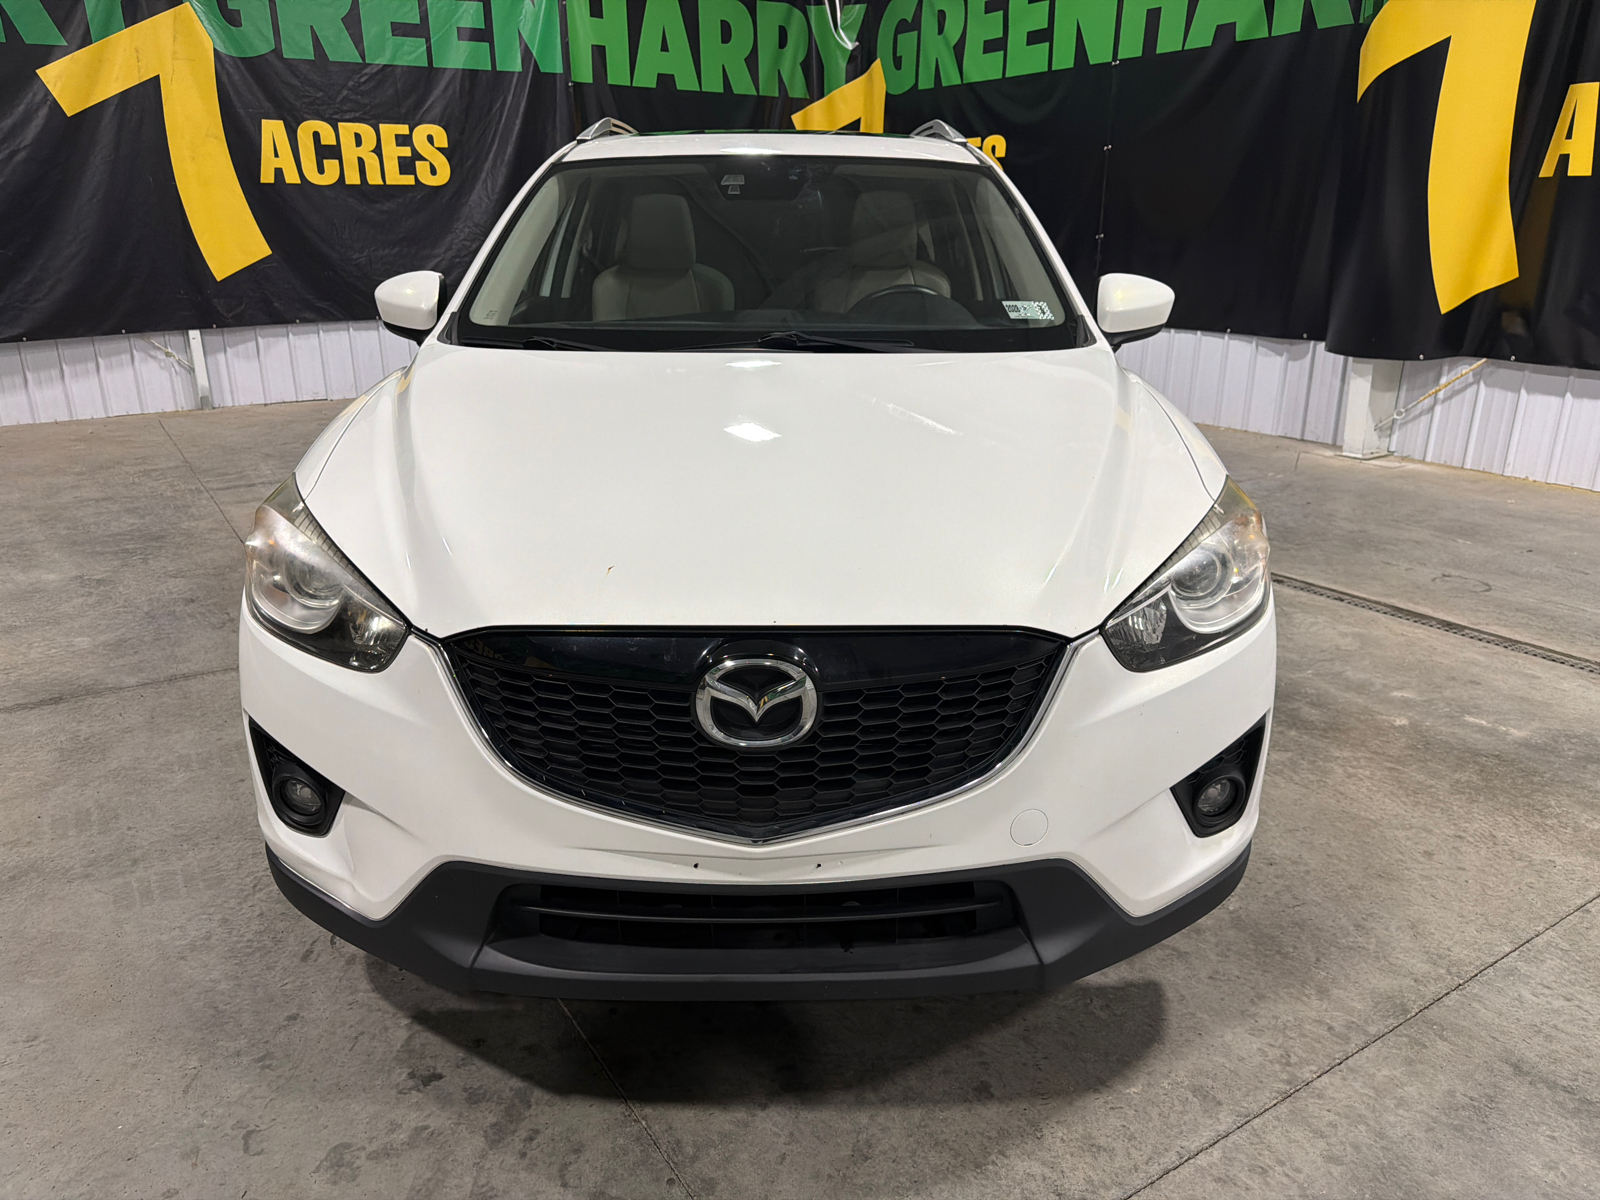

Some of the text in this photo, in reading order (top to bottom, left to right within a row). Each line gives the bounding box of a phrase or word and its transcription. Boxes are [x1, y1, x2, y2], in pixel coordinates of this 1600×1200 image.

[36, 1, 272, 282] 7
[567, 0, 1118, 98] HARRY GREEN
[259, 118, 451, 186] ACRES
[1357, 0, 1534, 314] 7
